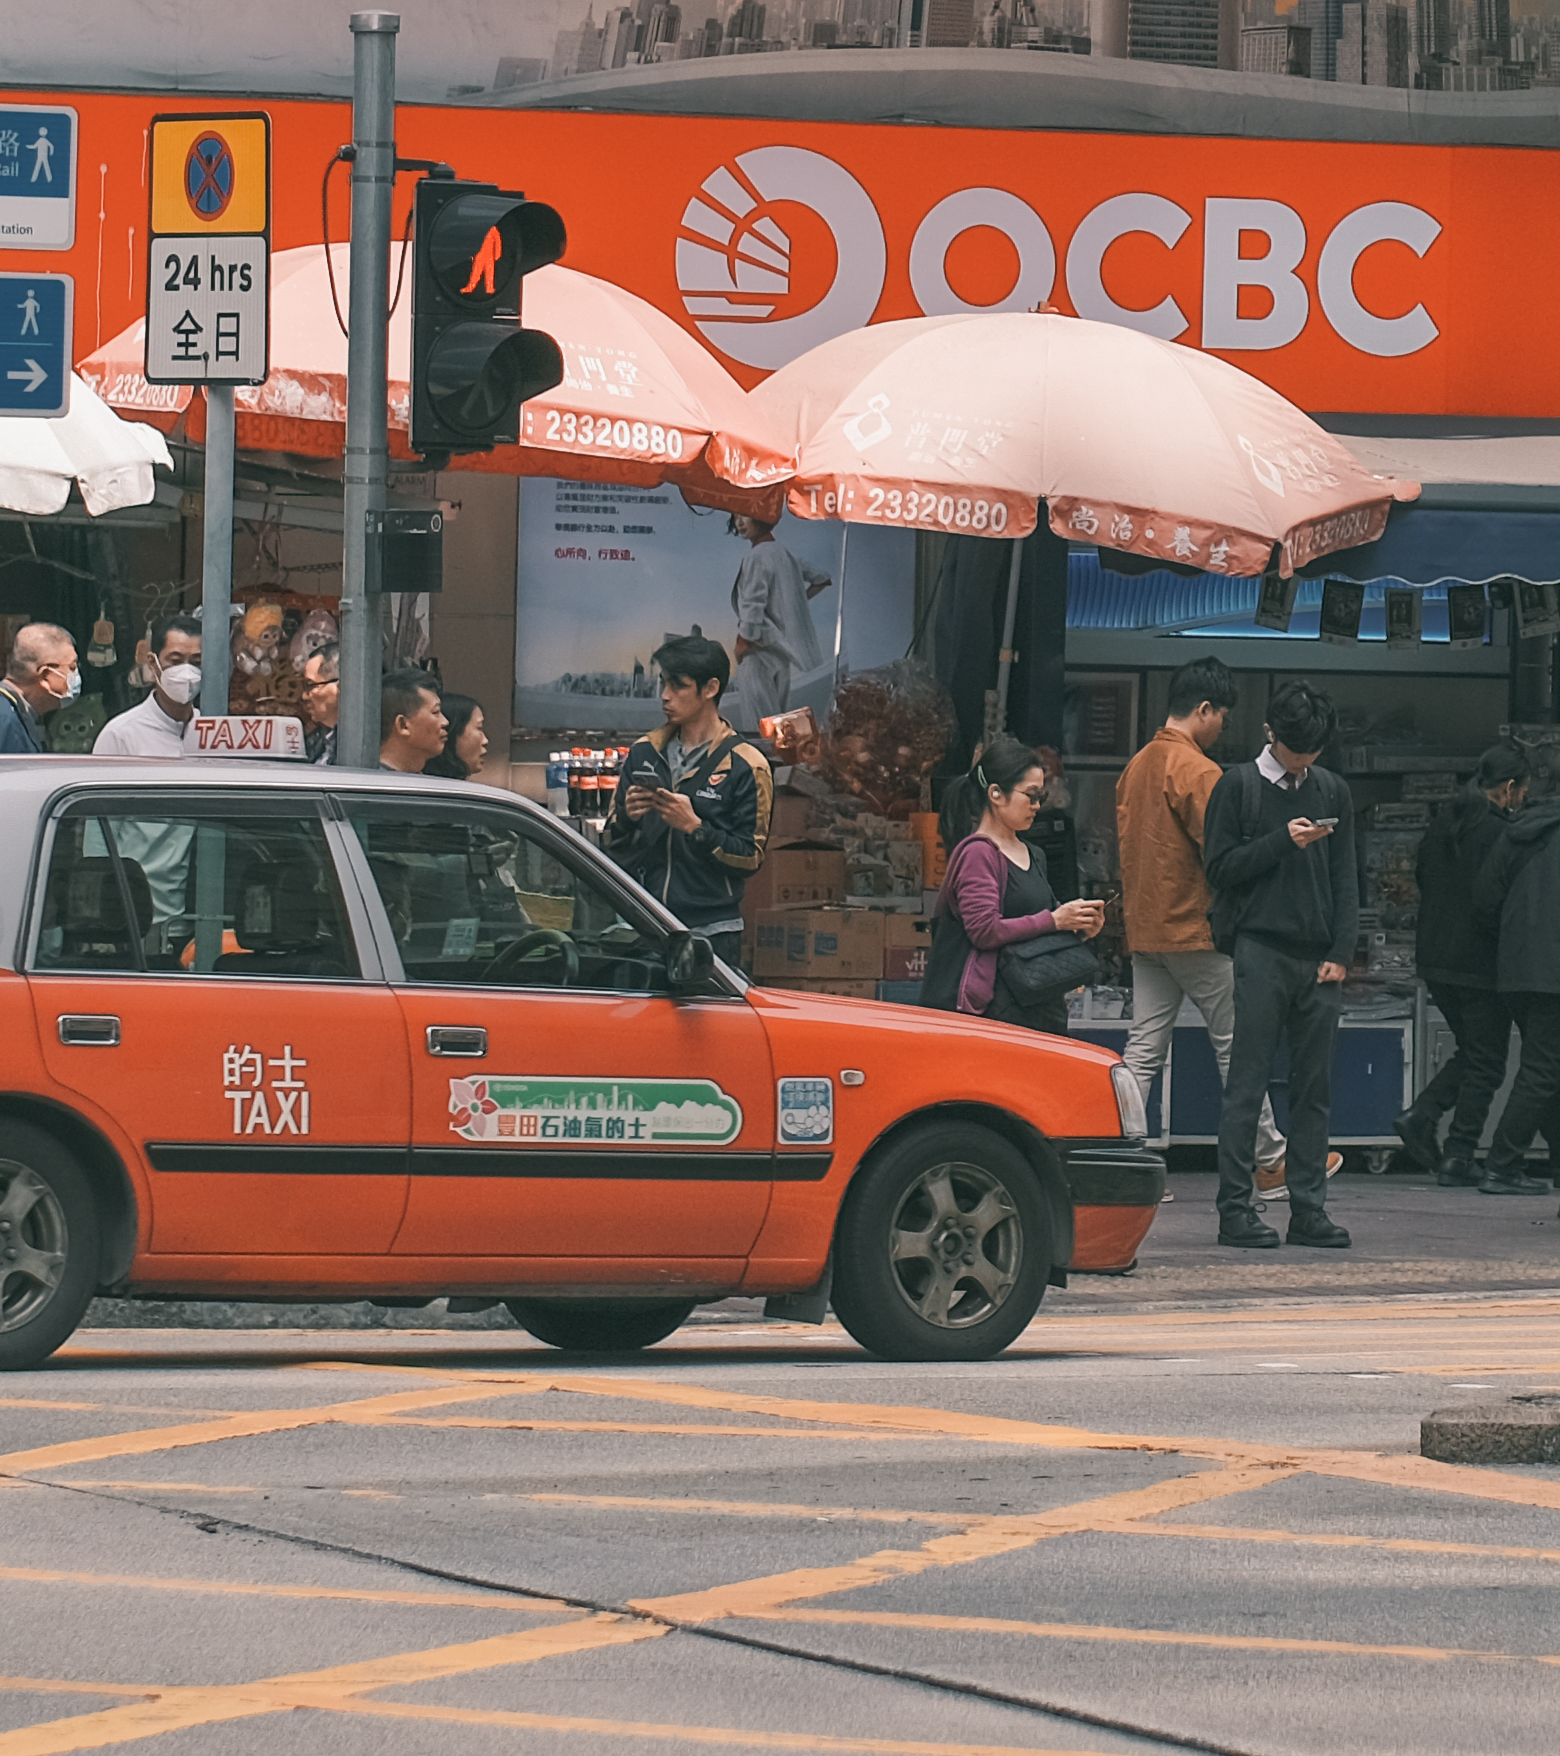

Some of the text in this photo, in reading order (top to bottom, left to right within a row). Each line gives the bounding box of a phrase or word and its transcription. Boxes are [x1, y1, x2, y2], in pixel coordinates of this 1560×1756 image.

[164, 254, 252, 292] 24 hrs
[908, 185, 1443, 358] OCBC
[171, 309, 240, 363] 全日
[564, 354, 643, 387] 門堂
[546, 409, 683, 459] 23320880
[804, 482, 1008, 532] Tel: 23320880
[195, 719, 273, 750] TAXI
[222, 1045, 307, 1089] 的士
[224, 1090, 311, 1136] TAXI
